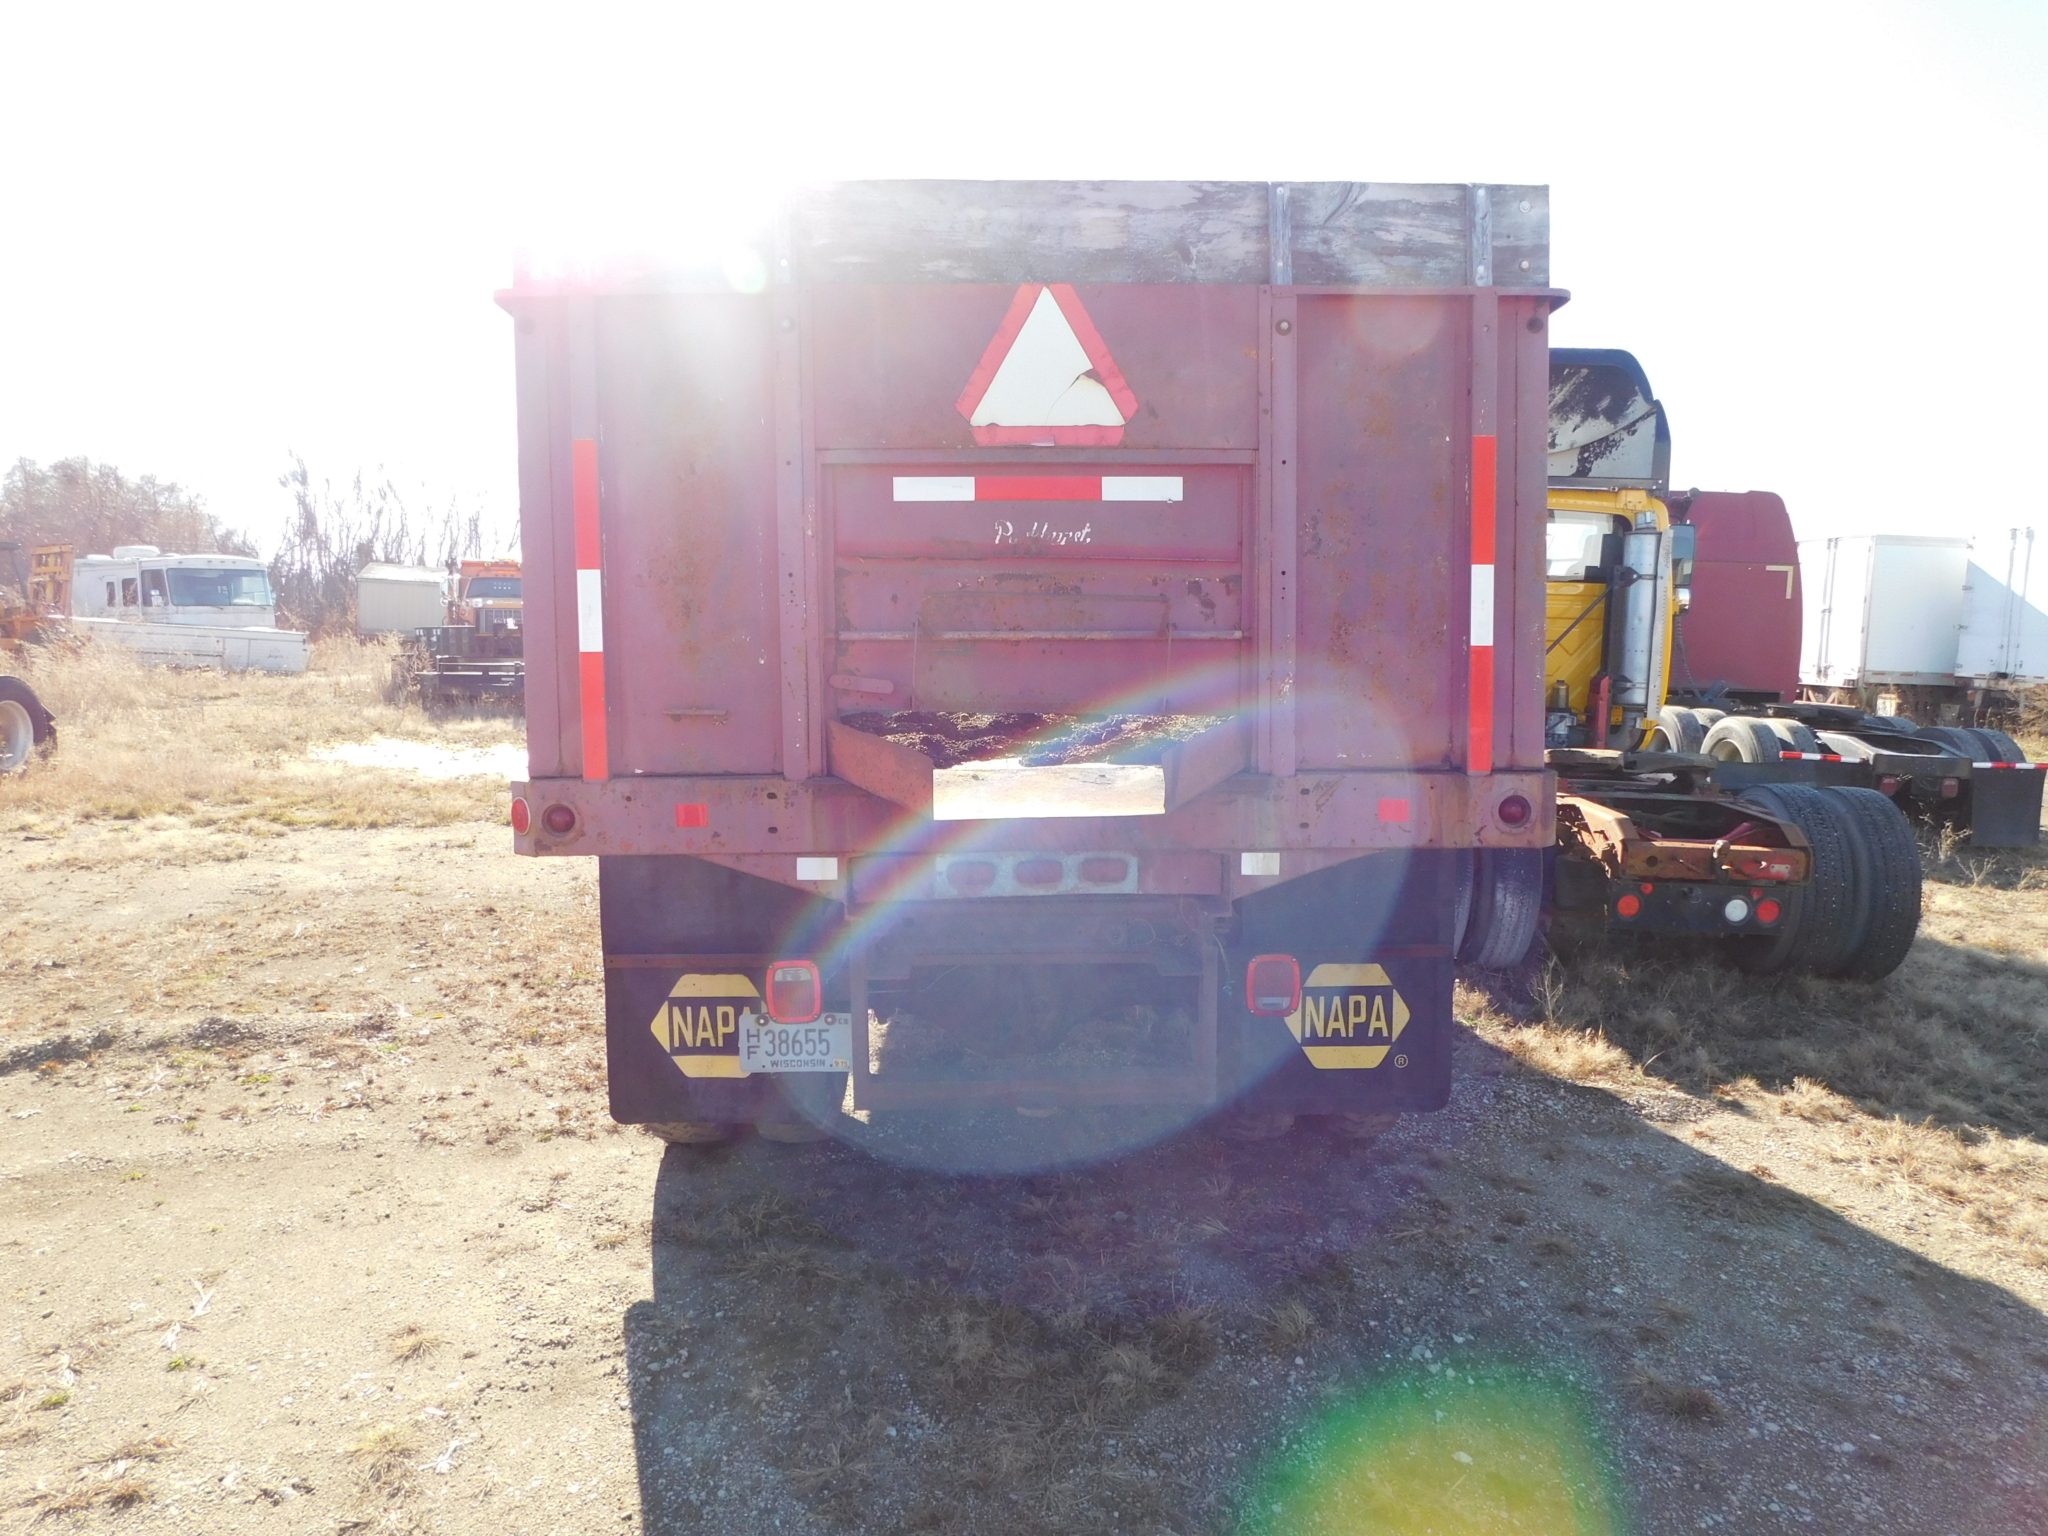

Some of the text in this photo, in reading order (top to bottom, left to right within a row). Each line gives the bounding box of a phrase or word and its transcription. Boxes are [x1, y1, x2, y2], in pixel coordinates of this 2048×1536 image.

[672, 1005, 751, 1048] NAP
[1304, 994, 1389, 1038] NAPA
[764, 1028, 830, 1057] 38655
[769, 1059, 826, 1068] WISCONSIN
